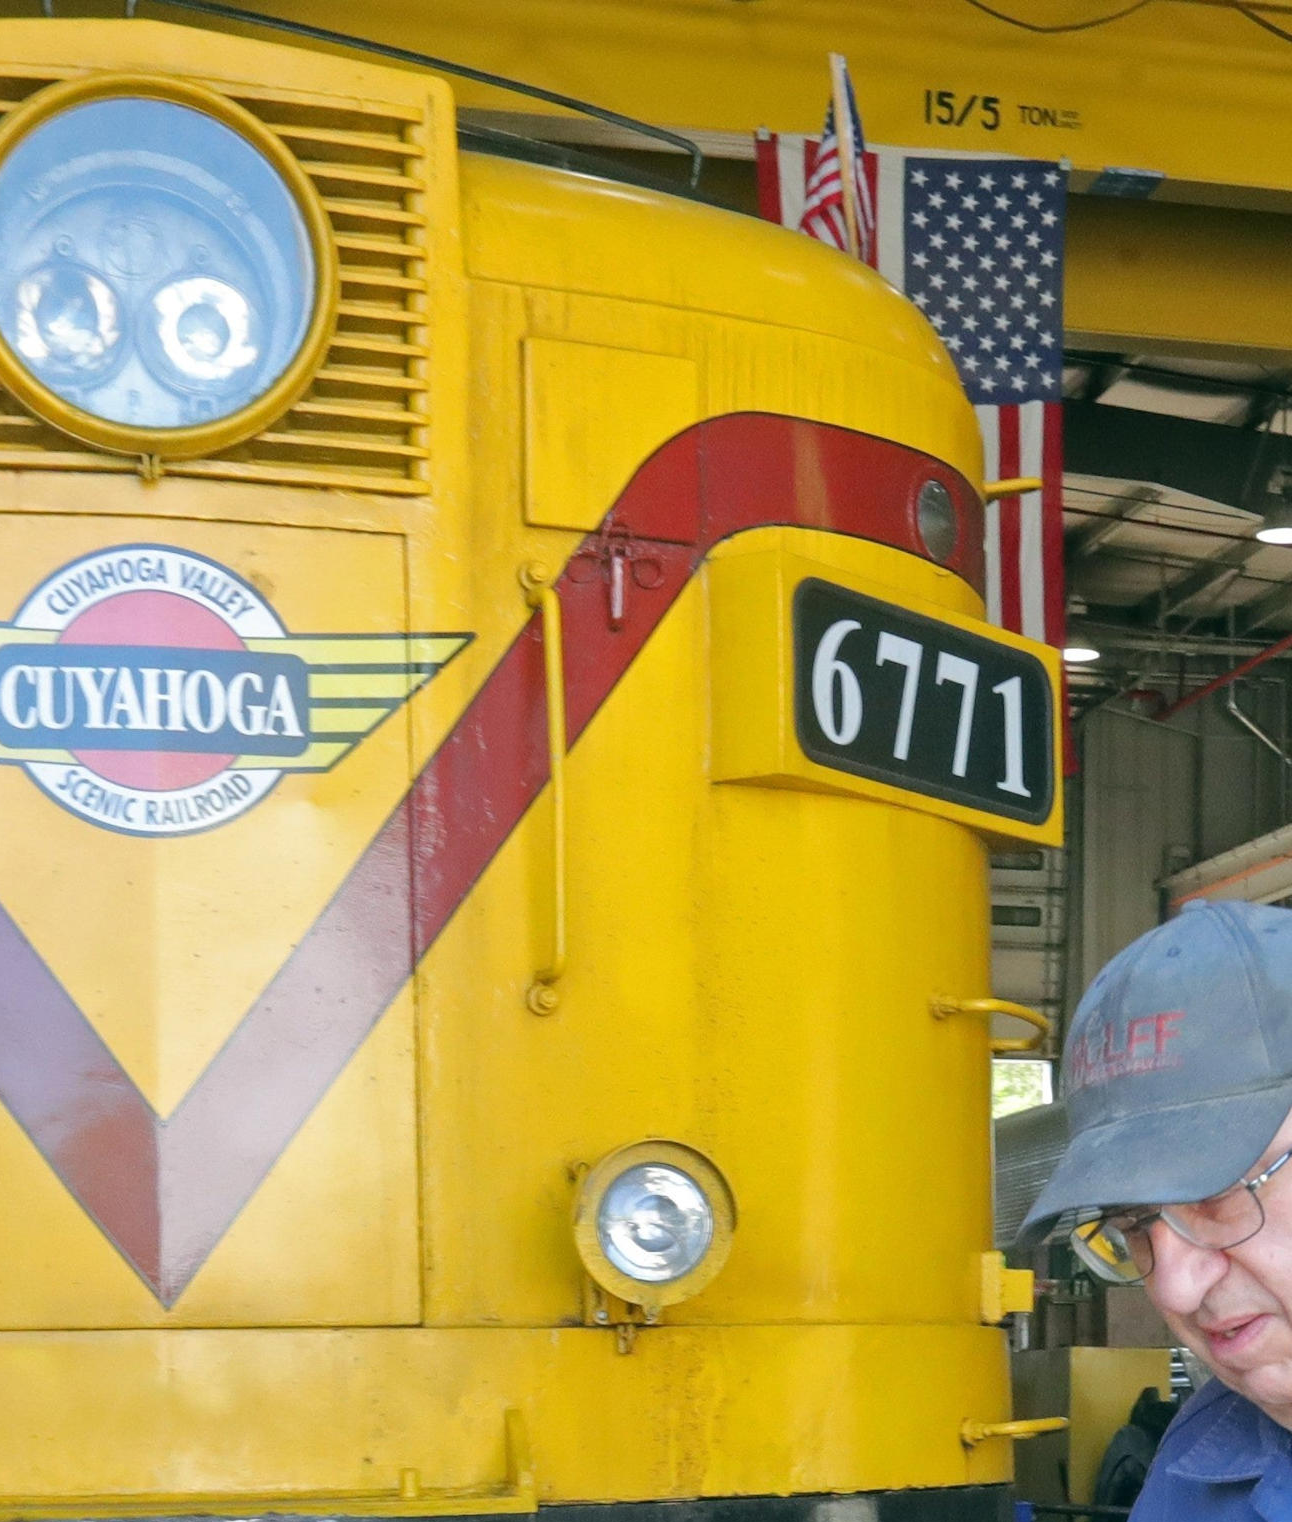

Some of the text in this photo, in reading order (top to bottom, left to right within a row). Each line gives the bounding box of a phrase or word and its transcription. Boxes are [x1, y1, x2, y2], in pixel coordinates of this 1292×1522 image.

[924, 89, 1001, 131] 15/5
[1017, 105, 1058, 126] TON
[46, 557, 255, 619] CUYAHOGA VALLEY
[812, 619, 1031, 798] 6771
[57, 769, 253, 825] SCENIC RAILROAD
